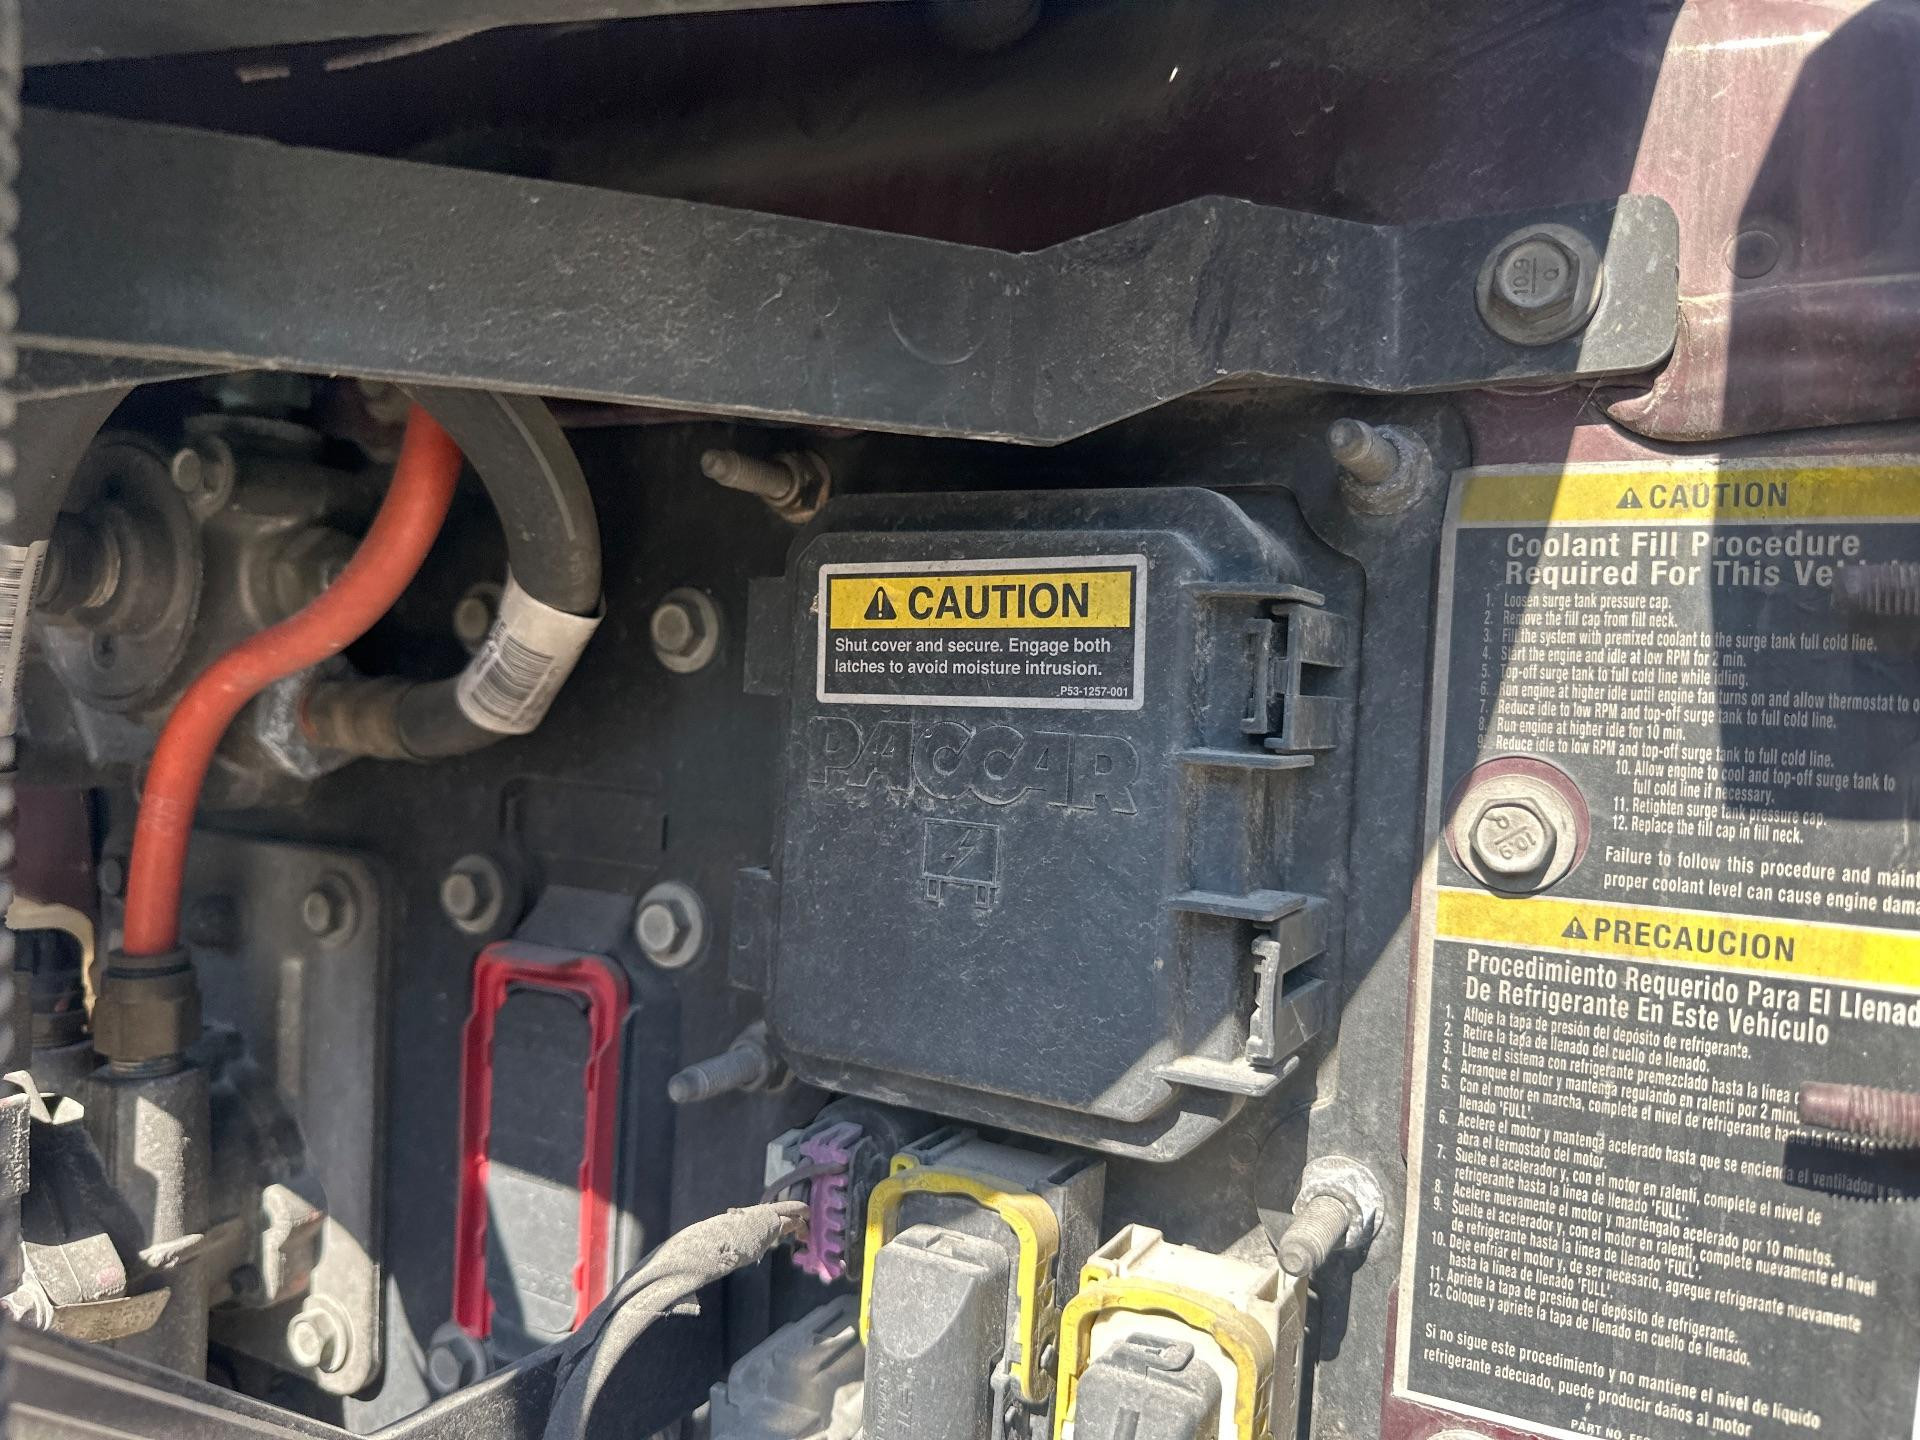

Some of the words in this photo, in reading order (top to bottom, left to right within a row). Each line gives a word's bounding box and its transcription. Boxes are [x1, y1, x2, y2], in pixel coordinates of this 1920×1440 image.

[1650, 481, 1788, 509] CAUTION
[1507, 532, 1619, 557] Coolant
[1631, 532, 1678, 557] Fill
[1692, 531, 1861, 557] Procedure
[1505, 560, 1638, 589] Required
[1650, 560, 1701, 586] For
[1714, 560, 1780, 586] This
[908, 582, 1090, 620] CAUTION
[1486, 593, 1494, 607] 1.
[1505, 593, 1538, 608] Loosen
[1543, 597, 1570, 612] surge
[1574, 593, 1597, 608] tank
[1600, 597, 1646, 612] pressure
[1649, 597, 1671, 612] cap.
[1485, 610, 1493, 624] 2.
[1504, 611, 1542, 625] Remove
[1545, 612, 1561, 626] the
[1565, 612, 1578, 626] fill
[1582, 615, 1599, 630] cap
[1604, 613, 1627, 627] from
[1632, 613, 1645, 627] fill
[1649, 614, 1677, 628] neck.
[835, 637, 869, 653] Shut
[872, 640, 912, 653] cover
[915, 638, 943, 653] and
[948, 640, 1003, 653] secure.
[1009, 638, 1069, 656] Engage
[1073, 638, 1111, 653] both
[835, 659, 885, 674] latches
[889, 660, 904, 674] to
[907, 659, 948, 675] avoid
[952, 661, 1021, 675] moisture
[1025, 660, 1103, 676] intrusion.
[1060, 685, 1128, 697] P53-1257-001
[807, 715, 1138, 815] PACCAR
[1613, 815, 1627, 830] 12.
[1632, 816, 1673, 836] Replace
[1677, 820, 1694, 835] the
[1698, 821, 1712, 837] fill
[1716, 826, 1735, 842] cap
[1739, 826, 1749, 839] in
[1755, 826, 1769, 841] fill
[1773, 829, 1803, 844] neck.
[1614, 796, 1628, 812] 11.
[1633, 798, 1683, 818] Retighten
[1687, 805, 1717, 821] surge
[1721, 806, 1745, 820] tank
[1750, 810, 1799, 825] pressure
[1803, 814, 1827, 830] cap.
[1606, 846, 1651, 865] Failure
[1658, 853, 1671, 866] to
[1678, 853, 1720, 870] follow
[1727, 857, 1753, 873] this
[1761, 862, 1835, 881] procedure
[1842, 868, 1869, 883] and
[1604, 873, 1646, 892] proper
[1653, 877, 1704, 894] coolant
[1709, 880, 1741, 898] level
[1747, 887, 1772, 901] can
[1778, 890, 1821, 905] cause
[1826, 894, 1876, 913] engine
[1593, 917, 1795, 962] PRECAUCION
[1467, 948, 1617, 989] Procedimiento
[1625, 966, 1738, 1004] Requerido
[1747, 980, 1800, 1012] Para
[1809, 987, 1831, 1016] El
[1465, 976, 1491, 1000] De
[1498, 979, 1629, 1019] Refrigerante
[1637, 997, 1664, 1024] En
[1672, 1000, 1719, 1031] Este
[1728, 1007, 1829, 1045] Vehículo
[1444, 1021, 1452, 1036] 2.
[1463, 1023, 1494, 1041] Retire
[1497, 1028, 1505, 1043] la
[1509, 1032, 1531, 1049] tapa
[1535, 1033, 1547, 1049] de
[1551, 1035, 1589, 1055] llenado
[1593, 1042, 1608, 1058] del
[1613, 1047, 1644, 1062] cuello
[1648, 1049, 1661, 1065] de
[1666, 1052, 1710, 1072] llenado.
[1446, 1003, 1454, 1018] 1.
[1464, 1005, 1493, 1026] Afloje
[1497, 1010, 1505, 1025] la
[1509, 1013, 1532, 1031] tapa
[1535, 1015, 1548, 1030] de
[1551, 1021, 1590, 1036] presión
[1594, 1023, 1609, 1039] del
[1613, 1026, 1659, 1046] depósito
[1663, 1033, 1676, 1048] de
[1681, 1037, 1751, 1059] refrigerante.
[1460, 1094, 1495, 1114] llenado
[1457, 1131, 1479, 1147] abra
[1483, 1135, 1492, 1149] el
[1496, 1138, 1549, 1159] termostato
[1554, 1146, 1569, 1162] del
[1574, 1153, 1607, 1169] motor.
[1430, 1264, 1444, 1281] 11.
[1447, 1268, 1482, 1289] Apriete
[1486, 1276, 1496, 1291] la
[1499, 1281, 1520, 1299] tapa
[1524, 1284, 1536, 1300] de
[1540, 1291, 1578, 1309] presión
[1582, 1297, 1598, 1314] del
[1602, 1301, 1647, 1324] depósito
[1652, 1311, 1664, 1327] de
[1668, 1317, 1738, 1343] refrigerante.
[1429, 1281, 1442, 1298] 12.
[1447, 1286, 1485, 1308] Coloque
[1489, 1298, 1493, 1313] y
[1498, 1300, 1533, 1318] apriete
[1537, 1305, 1546, 1320] la
[1550, 1310, 1572, 1329] tapa
[1576, 1314, 1588, 1330] de
[1592, 1317, 1631, 1339] llenado
[1635, 1330, 1647, 1343] en
[1651, 1334, 1684, 1351] cuello
[1688, 1338, 1701, 1354] de
[1706, 1342, 1750, 1365] llenado.
[1424, 1348, 1490, 1375] refrigerante
[1495, 1364, 1554, 1392] adecuado,
[1558, 1381, 1594, 1399] puede
[1599, 1391, 1650, 1413] producir
[1655, 1401, 1692, 1422] daños
[1697, 1412, 1709, 1427] al
[1713, 1419, 1752, 1437] motor
[1425, 1323, 1436, 1339] Si
[1440, 1330, 1453, 1342] no
[1457, 1333, 1487, 1351] sigue
[1491, 1342, 1515, 1357] este
[1520, 1349, 1604, 1378] procedimiento
[1609, 1369, 1615, 1384] y
[1620, 1372, 1634, 1385] no
[1639, 1377, 1696, 1399] mantiene
[1701, 1389, 1713, 1403] el
[1717, 1394, 1749, 1412] nivel
[1752, 1400, 1768, 1416] de
[1773, 1404, 1821, 1428] líquido
[1570, 1419, 1601, 1435] PART
